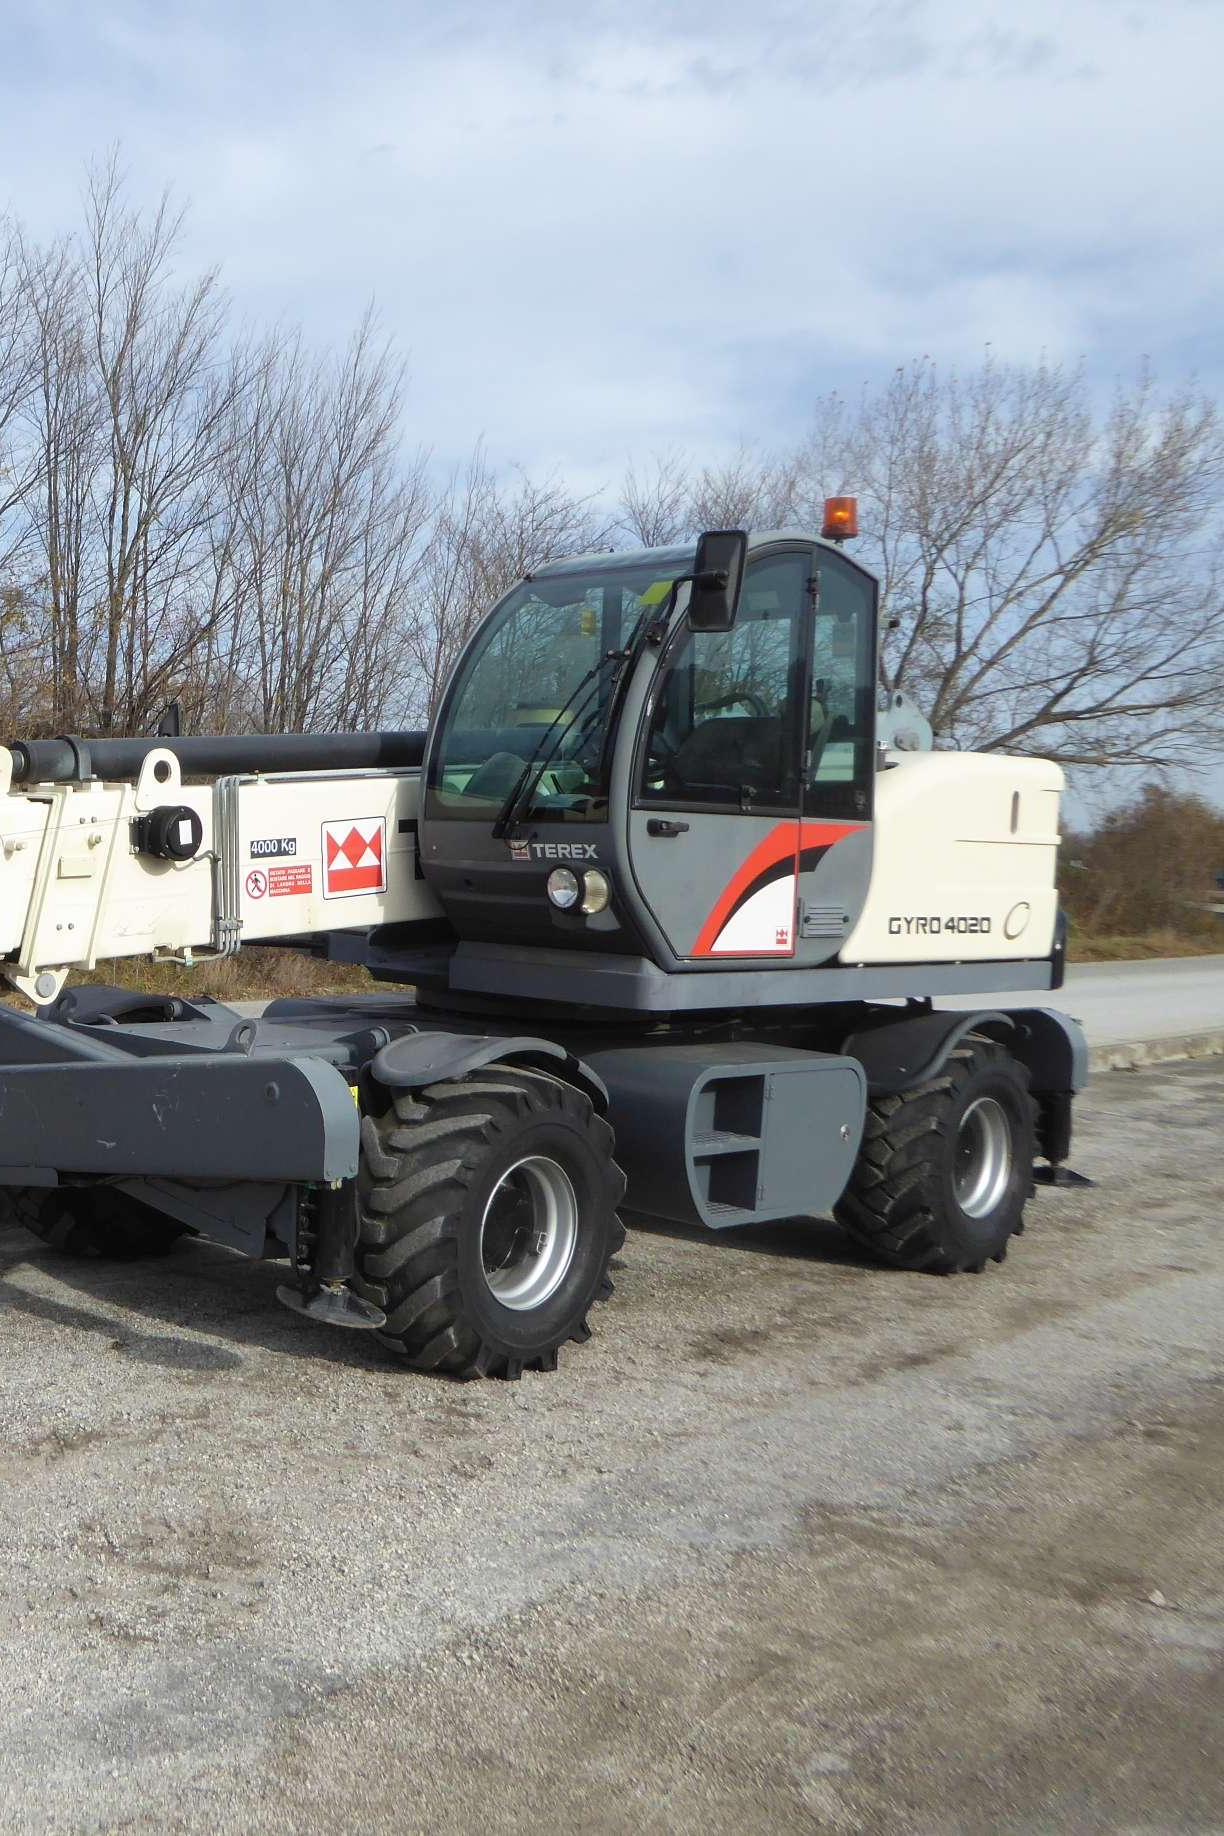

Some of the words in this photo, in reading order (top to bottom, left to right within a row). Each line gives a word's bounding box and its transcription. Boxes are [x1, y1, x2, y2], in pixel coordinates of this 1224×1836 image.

[251, 840, 277, 854] 4000
[281, 838, 295, 854] Kg
[531, 843, 598, 859] TEREX
[888, 916, 941, 935] GYRO
[944, 916, 992, 934] 4020
